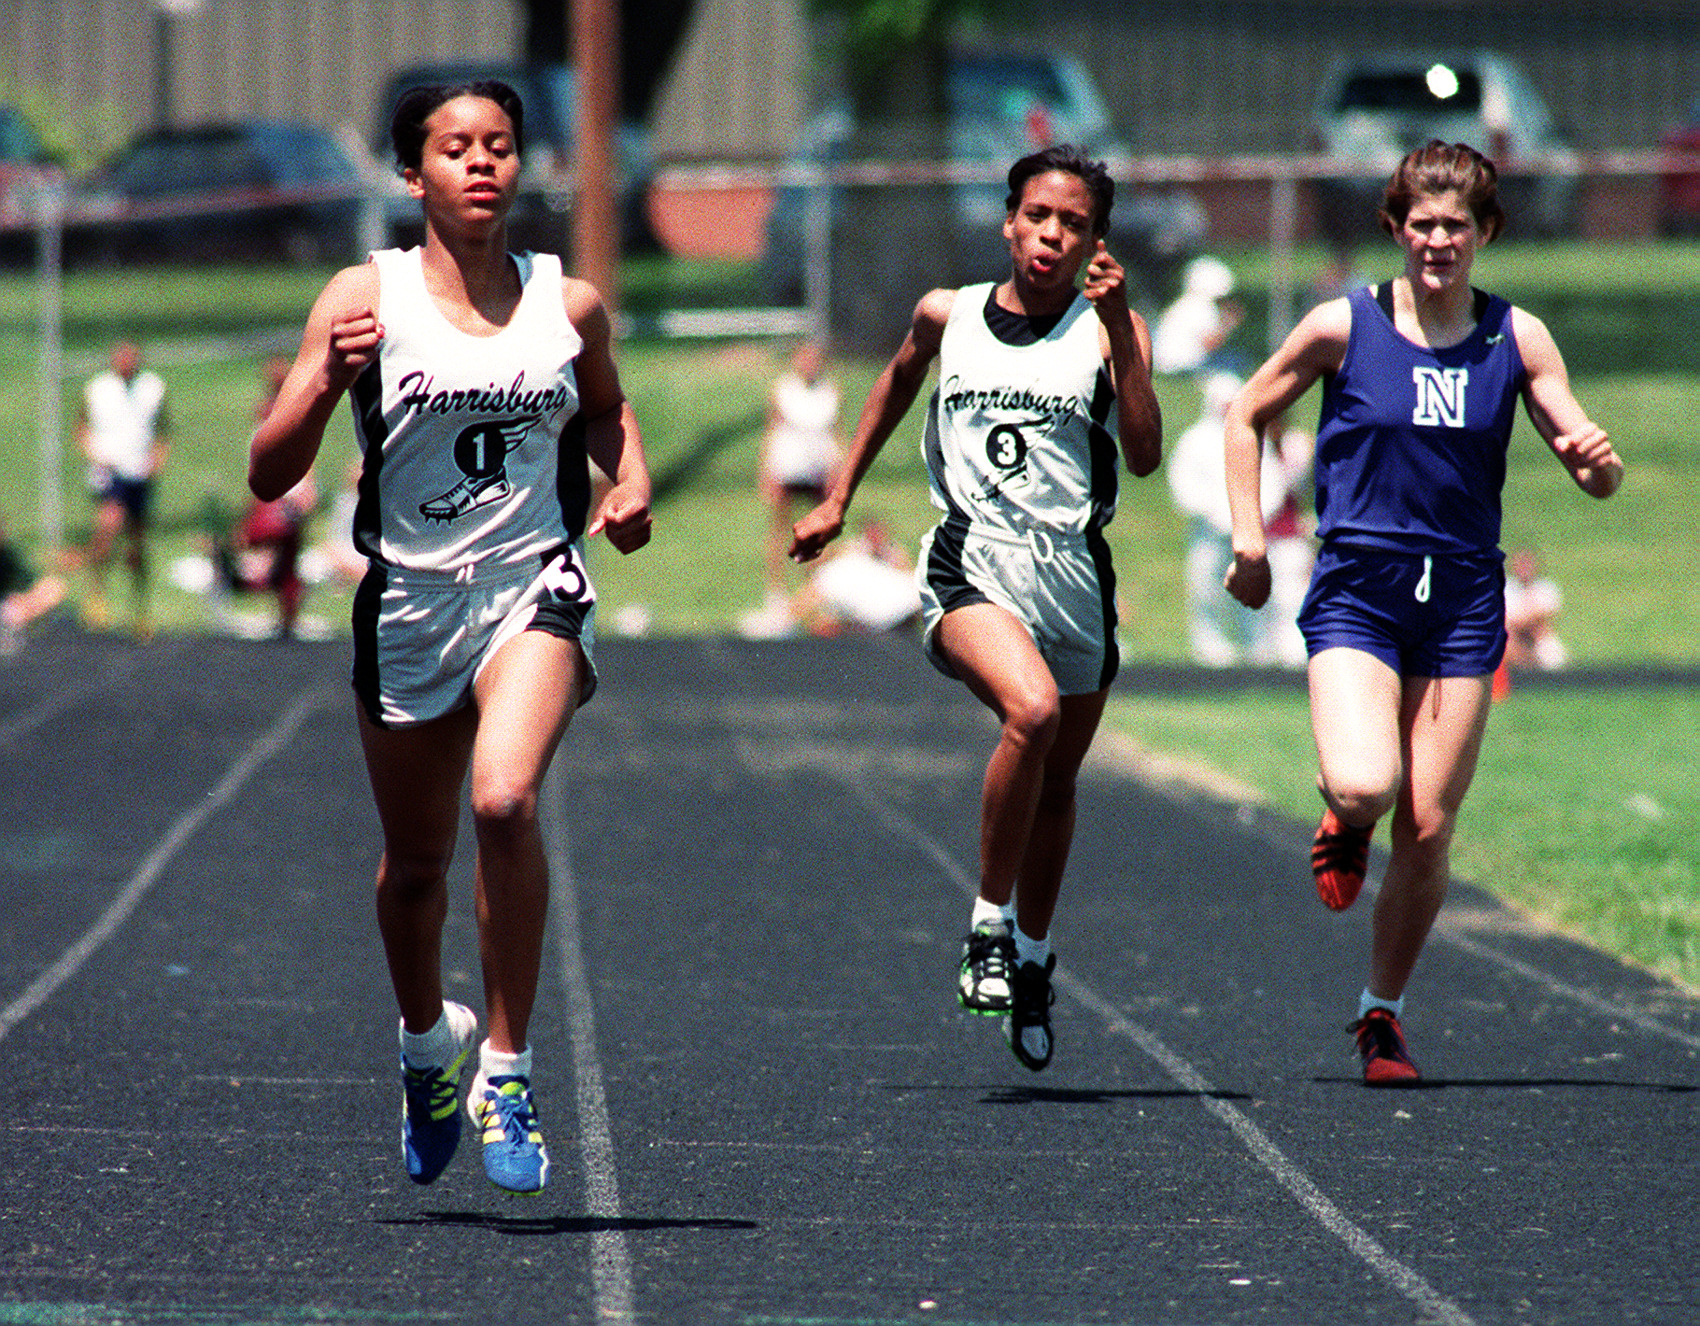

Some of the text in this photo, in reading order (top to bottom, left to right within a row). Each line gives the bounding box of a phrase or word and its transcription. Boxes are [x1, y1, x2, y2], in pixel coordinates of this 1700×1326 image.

[398, 370, 567, 425] Harrisburg
[944, 374, 1077, 427] Harrisburg
[1412, 366, 1469, 428] N
[473, 432, 485, 470] 1
[997, 431, 1017, 465] 3
[553, 544, 587, 601] 3
